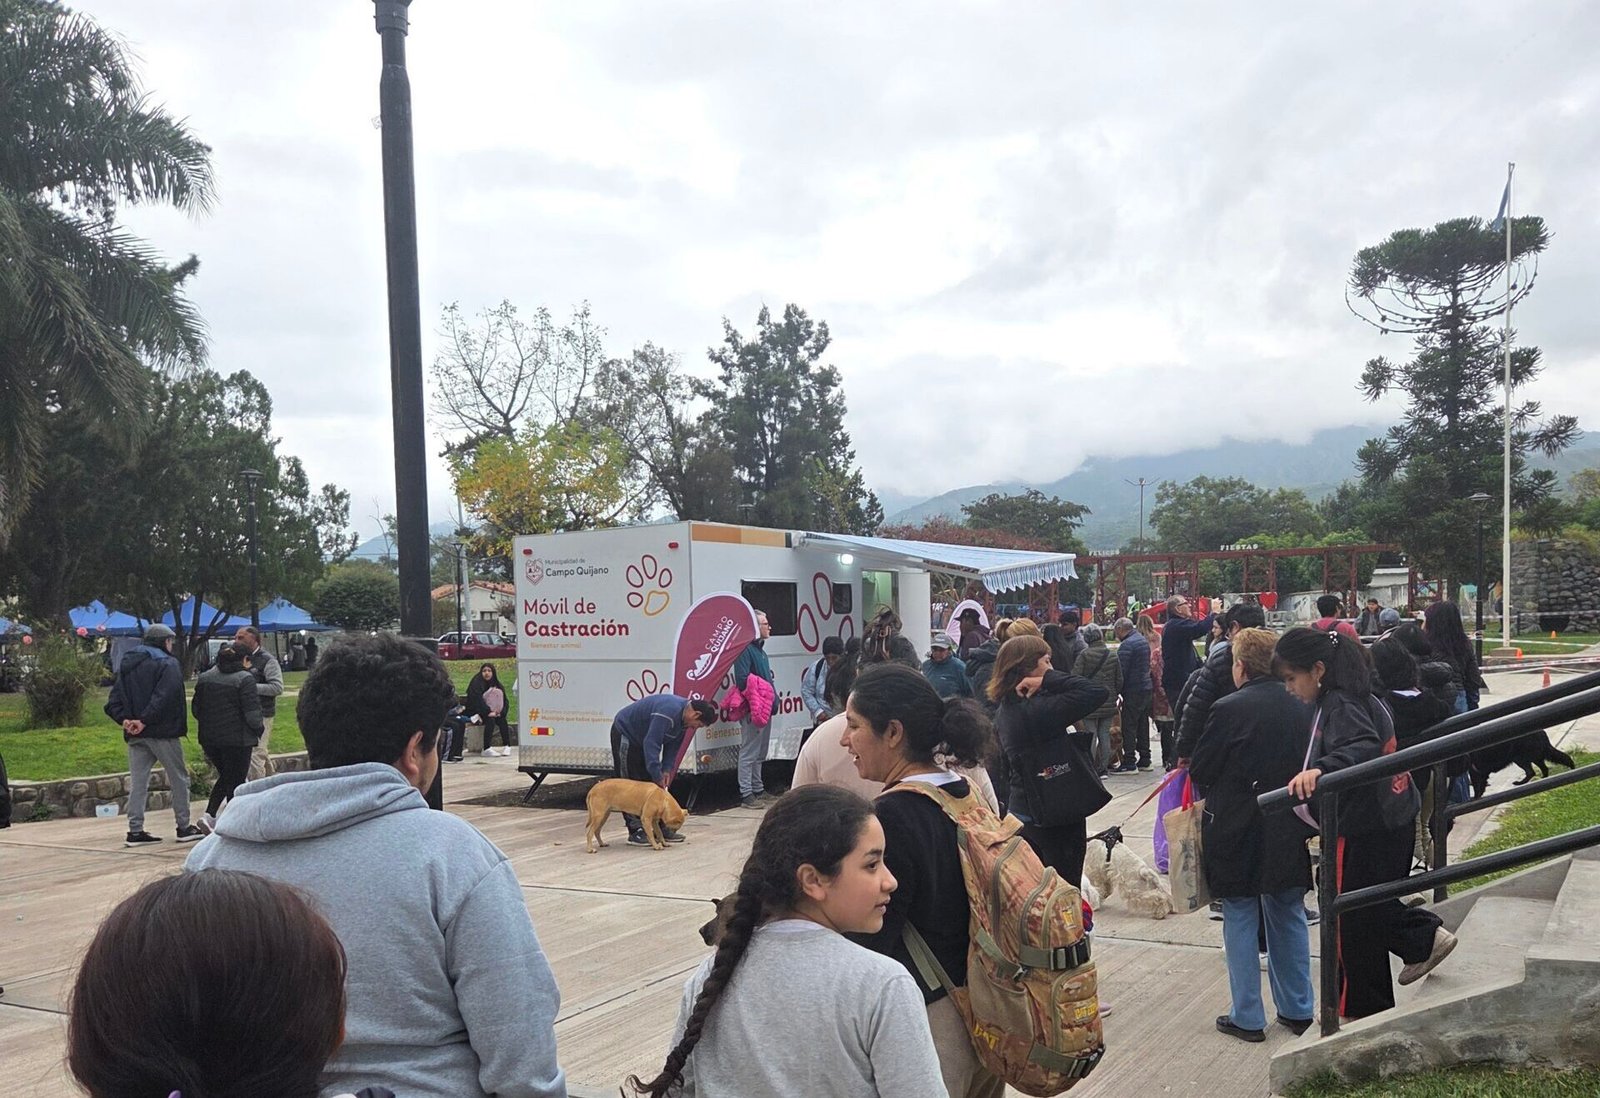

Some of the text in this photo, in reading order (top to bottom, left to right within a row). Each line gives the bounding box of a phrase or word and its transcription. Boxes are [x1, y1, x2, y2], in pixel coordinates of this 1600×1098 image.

[1220, 543, 1259, 551] FIESTAS
[545, 565, 609, 578] Campo Quijano
[524, 597, 596, 615] Móvil de
[524, 619, 630, 637] Castración
[705, 615, 728, 650] CAMPO
[710, 619, 734, 653] QUIJANO
[705, 727, 742, 739] Bienesta
